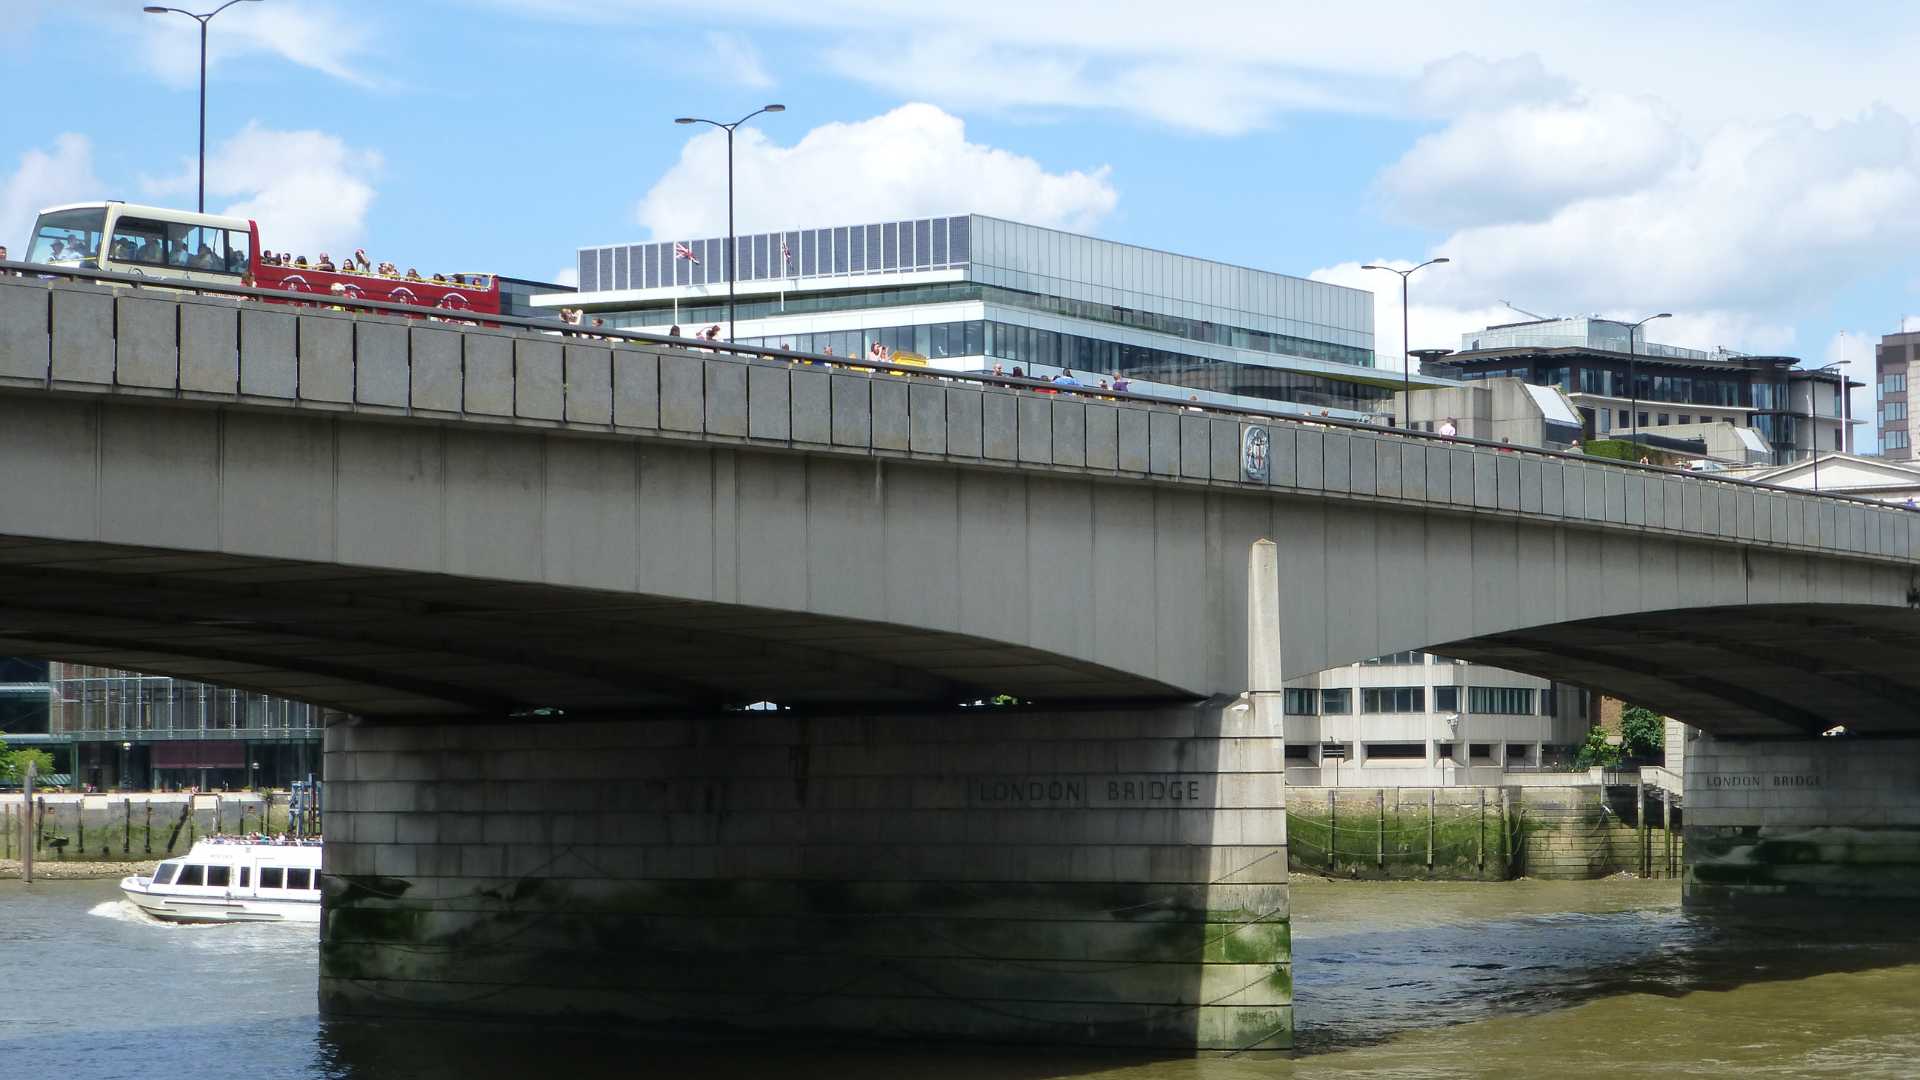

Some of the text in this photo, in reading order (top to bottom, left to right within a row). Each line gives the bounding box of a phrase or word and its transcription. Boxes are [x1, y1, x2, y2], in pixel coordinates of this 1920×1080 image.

[1706, 775, 1760, 786] LONDON
[979, 780, 1199, 801] LONDON BRIDGE
